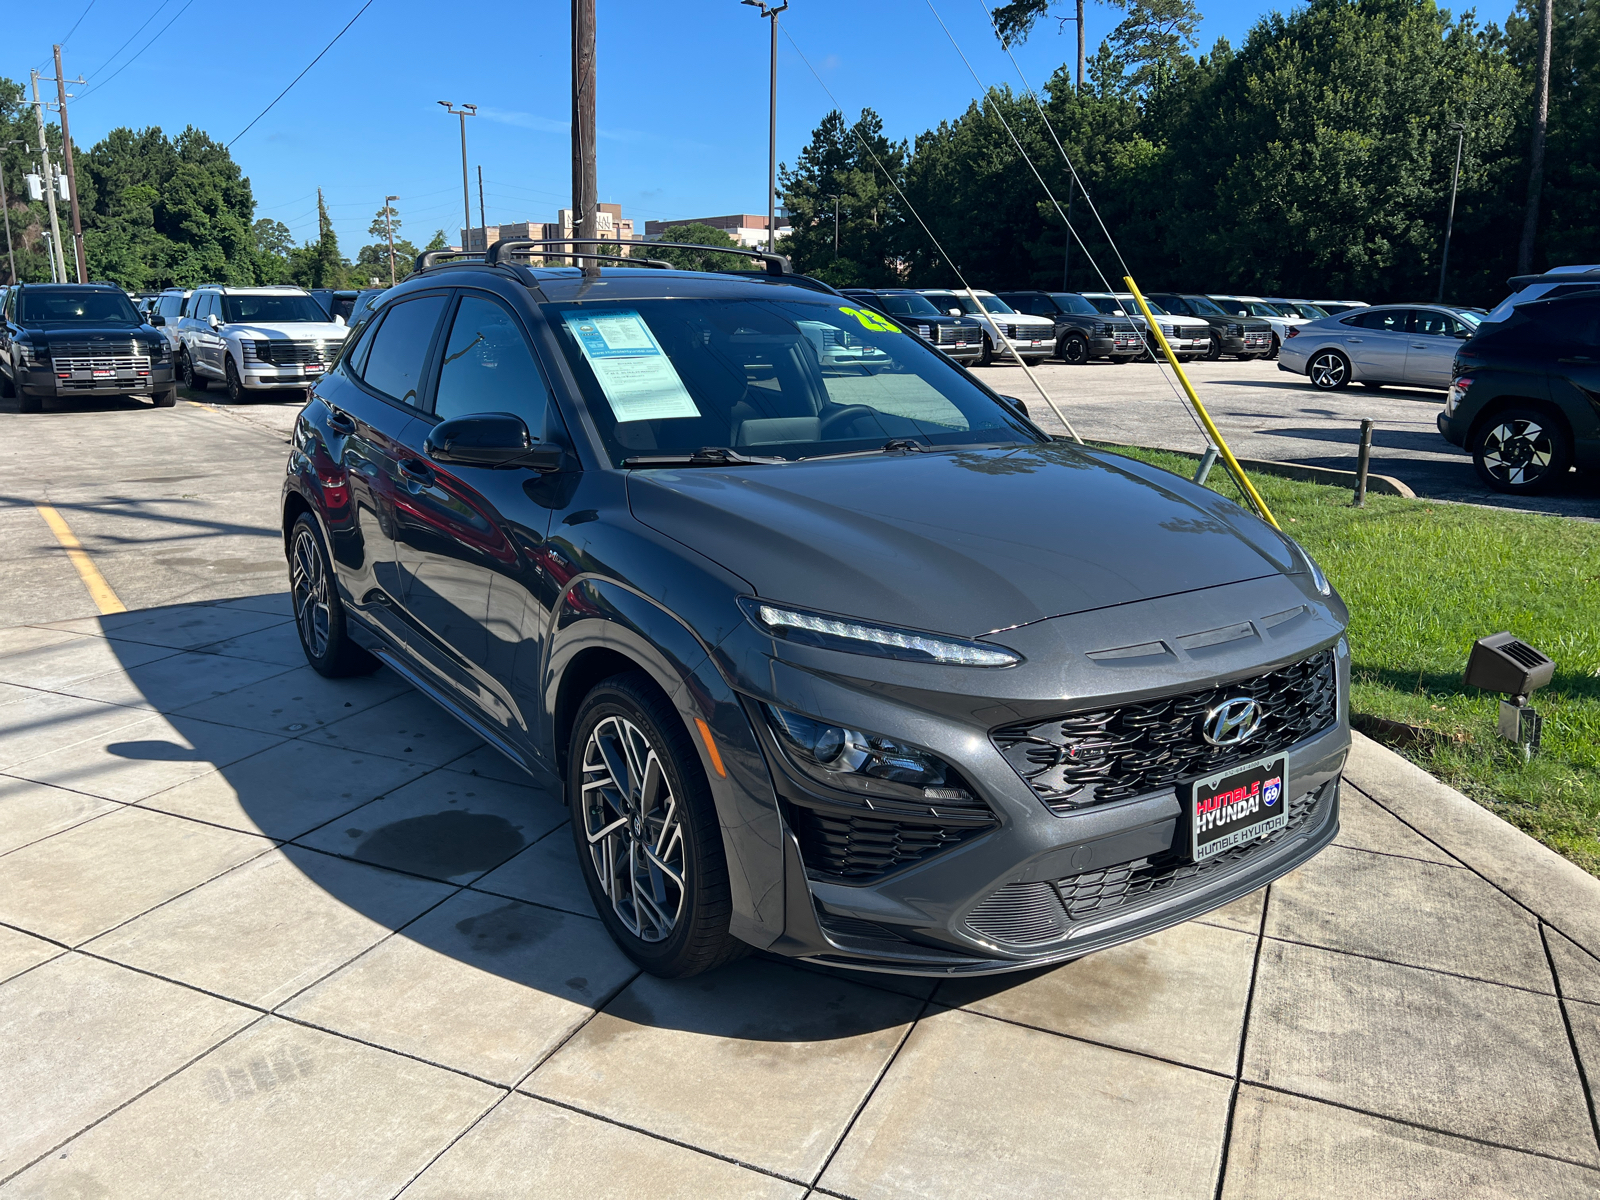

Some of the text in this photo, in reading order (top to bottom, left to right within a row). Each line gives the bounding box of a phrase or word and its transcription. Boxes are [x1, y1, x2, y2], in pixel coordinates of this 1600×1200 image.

[1197, 781, 1260, 816] HUMBLE
[1265, 787, 1278, 803] 69
[1197, 795, 1260, 834] HYUNDAI
[1197, 816, 1285, 859] HUMBLE HYUNDAI
